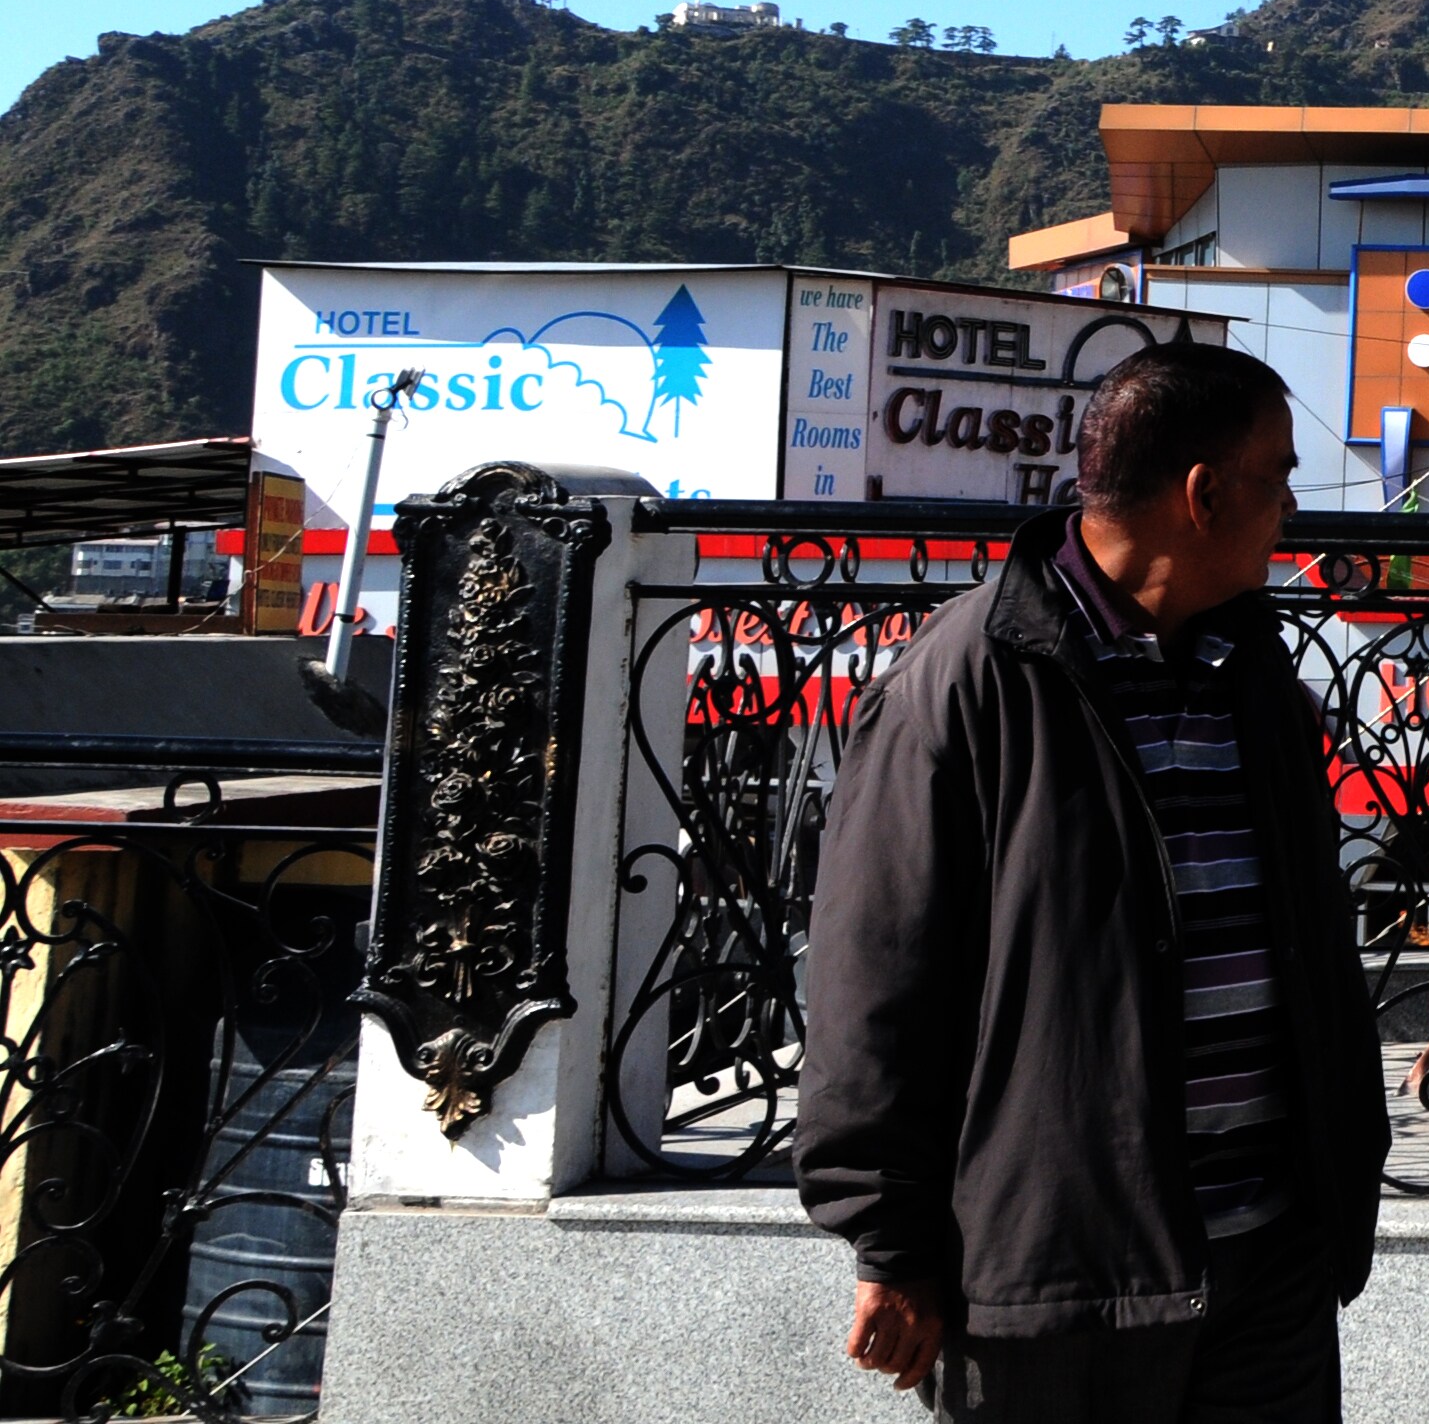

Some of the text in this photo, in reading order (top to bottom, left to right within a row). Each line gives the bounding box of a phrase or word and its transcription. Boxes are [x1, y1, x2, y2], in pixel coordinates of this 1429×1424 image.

[800, 285, 863, 310] we have
[315, 310, 421, 336] HOTEL
[811, 321, 849, 353] The
[887, 309, 1047, 371] HOTEL
[279, 352, 544, 411] Classic
[807, 369, 853, 400] Best
[790, 417, 861, 450] Rooms
[883, 386, 1079, 457] Classi
[814, 465, 836, 496] in
